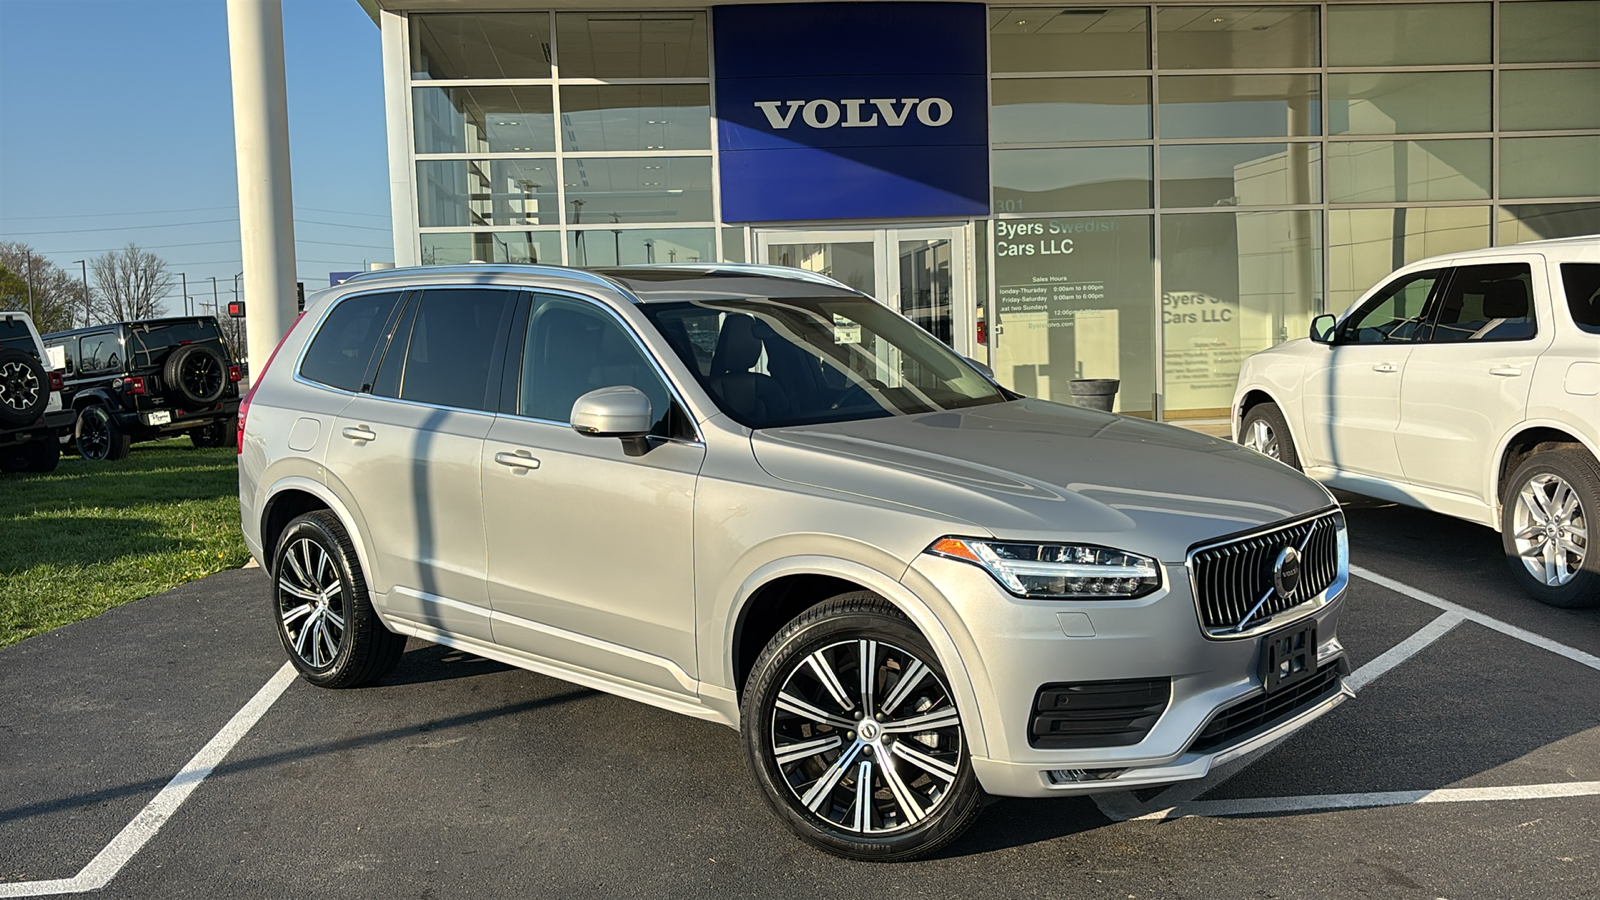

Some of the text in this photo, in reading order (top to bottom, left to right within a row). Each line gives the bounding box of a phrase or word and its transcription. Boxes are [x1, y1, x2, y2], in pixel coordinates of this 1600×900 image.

[754, 98, 953, 129] VOLVO
[996, 199, 1023, 212] 301
[996, 219, 1120, 239] Byers Swedish
[996, 238, 1074, 256] Cars LLC
